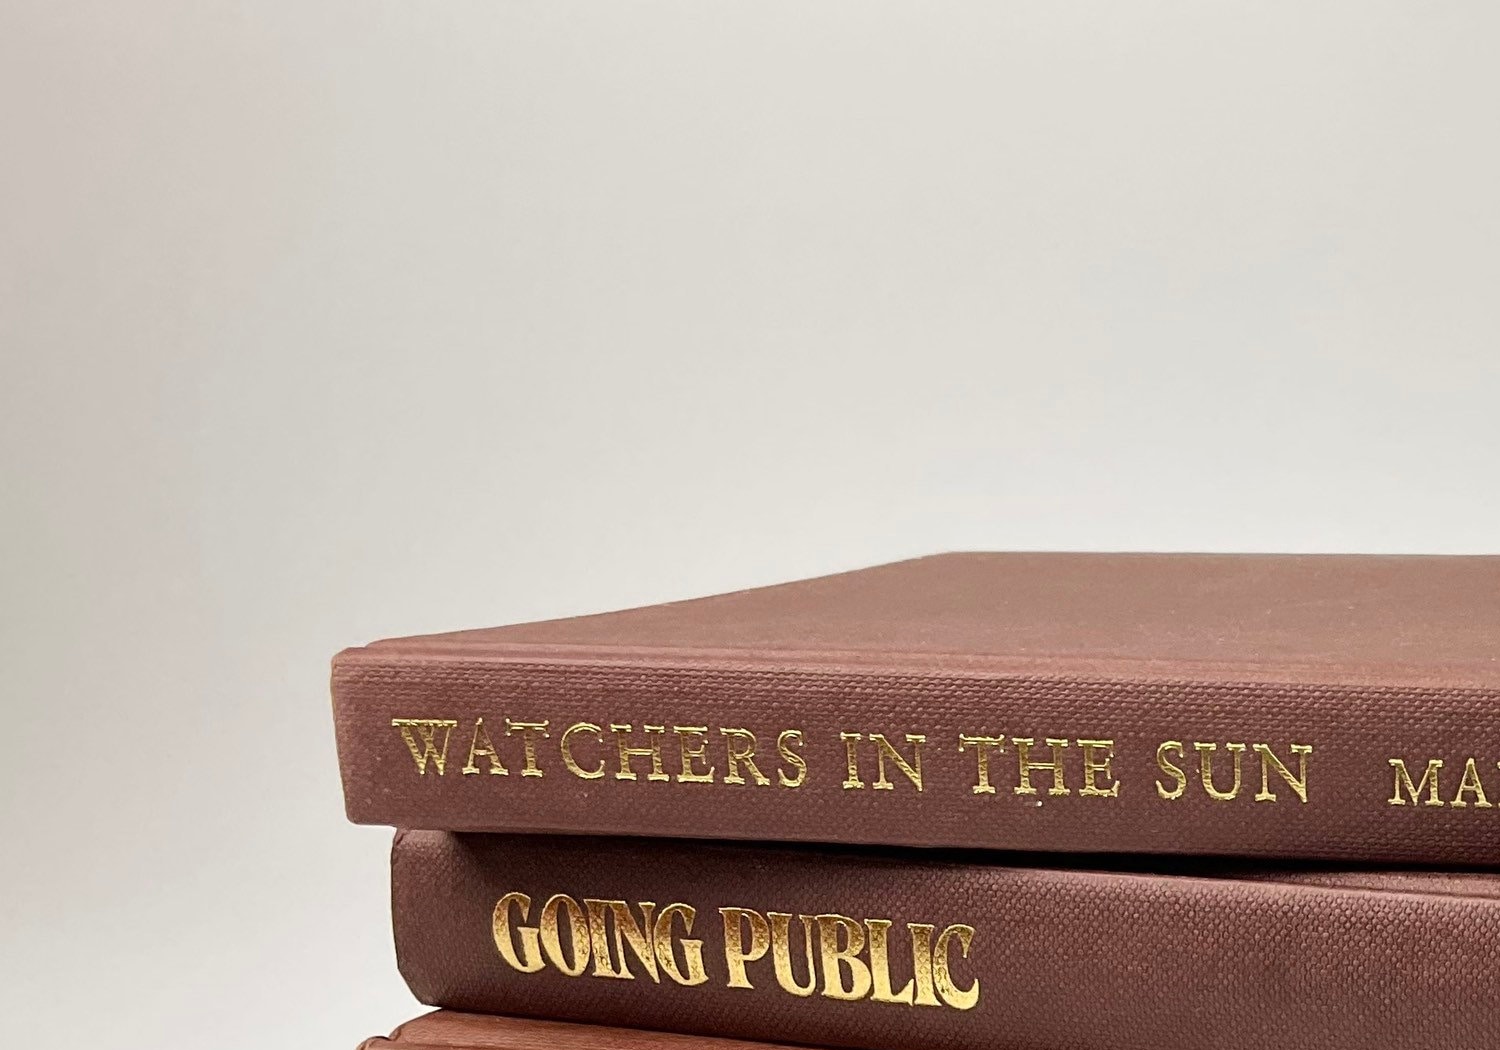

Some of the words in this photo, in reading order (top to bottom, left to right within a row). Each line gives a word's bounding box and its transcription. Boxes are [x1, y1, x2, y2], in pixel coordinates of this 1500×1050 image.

[393, 717, 805, 788] WATCHERS
[841, 732, 926, 792] IN
[959, 733, 1121, 798] THE
[1156, 739, 1312, 802] SUN
[491, 891, 705, 984] GOING
[718, 905, 980, 1010] PUBLIC
